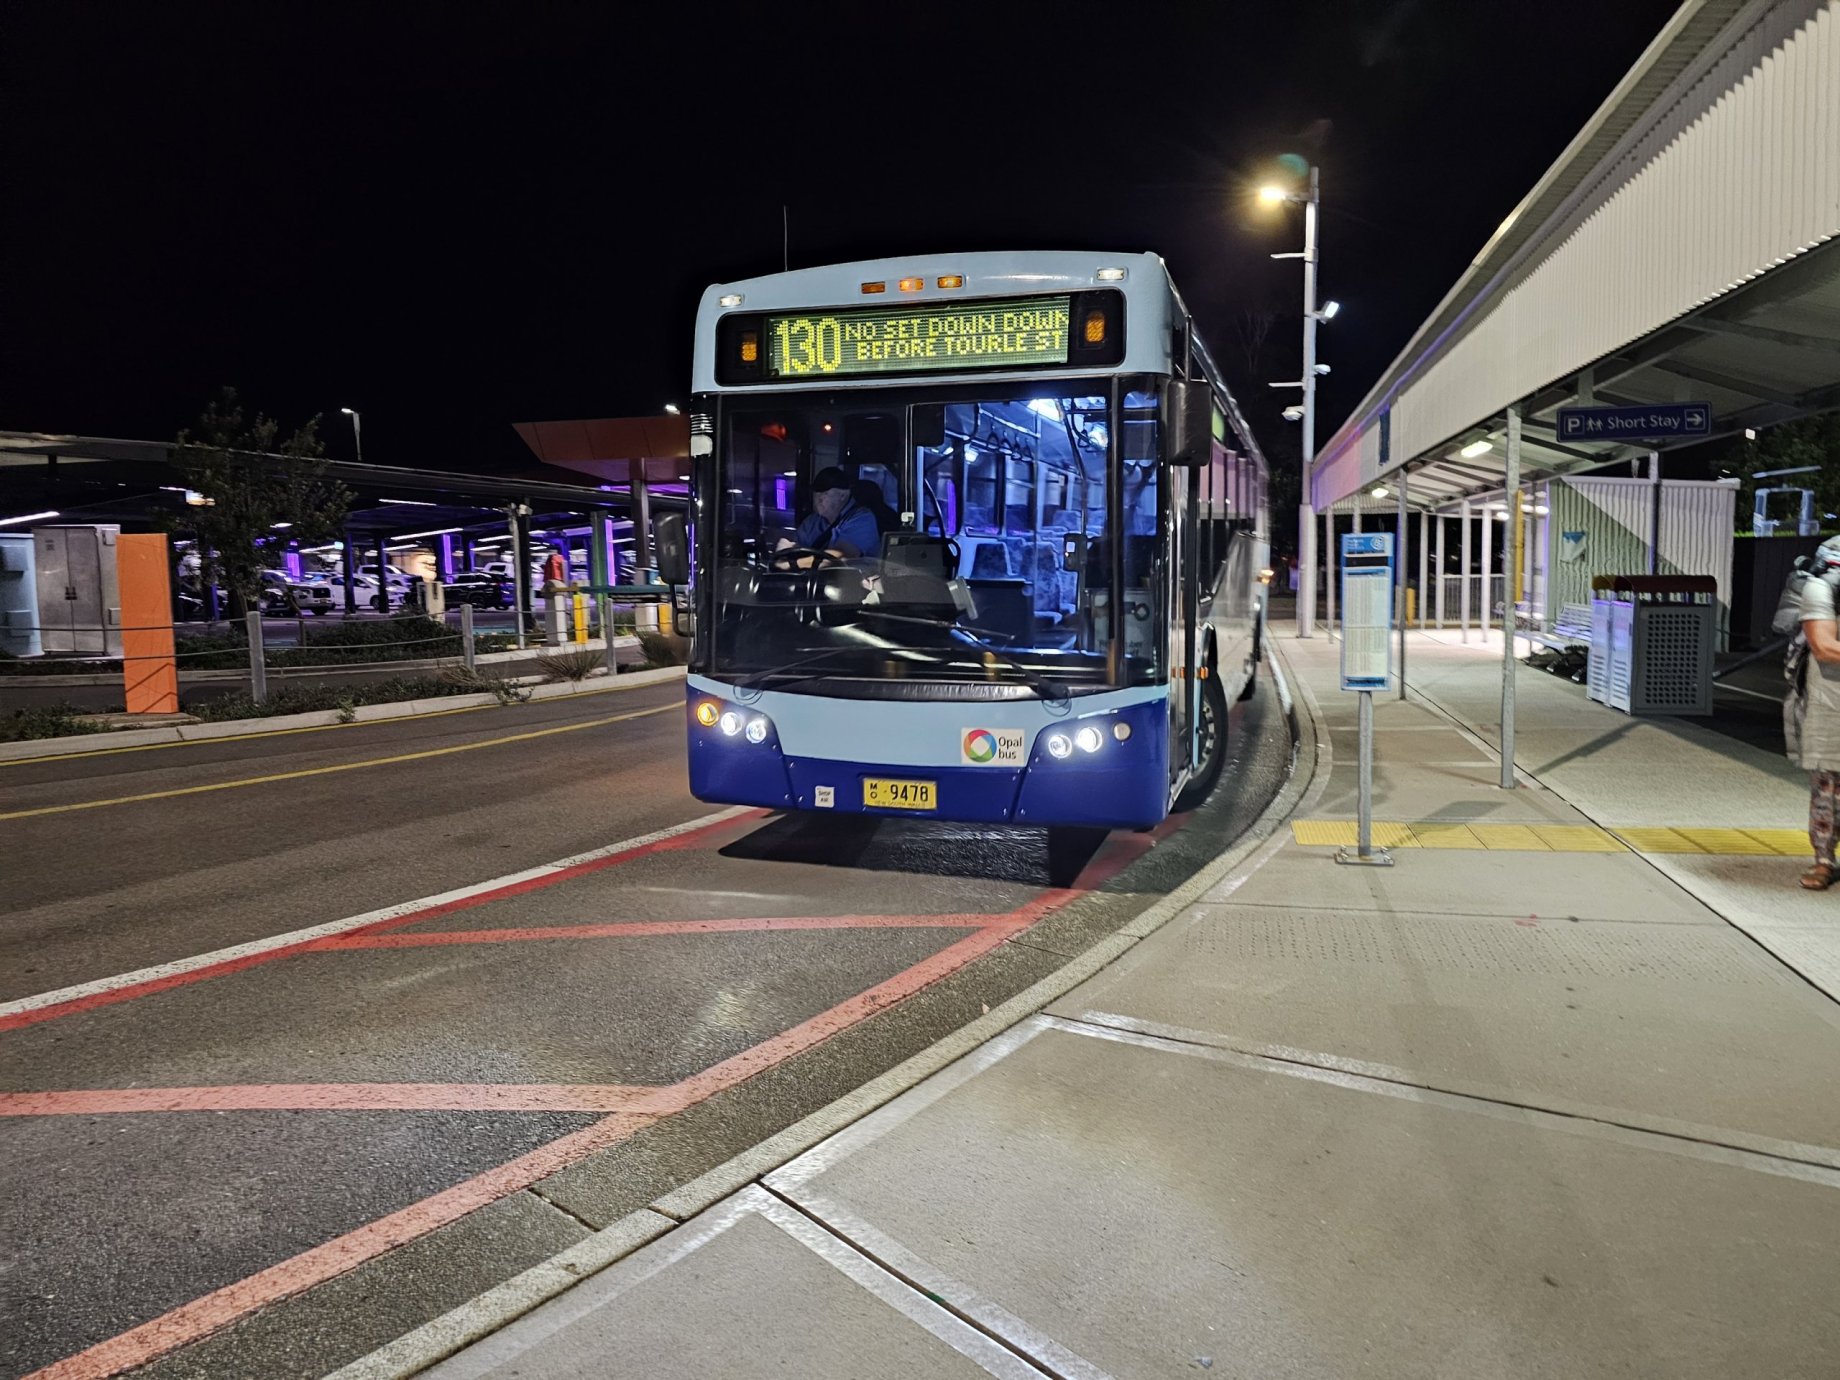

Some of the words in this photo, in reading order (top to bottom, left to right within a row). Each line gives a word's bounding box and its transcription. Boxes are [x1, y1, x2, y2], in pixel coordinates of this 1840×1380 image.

[845, 322, 876, 342] NO
[884, 319, 921, 338] SET
[928, 314, 995, 337] DOWN
[1003, 309, 1070, 333] DOWN
[776, 317, 841, 374] 130
[857, 337, 936, 360] BEFORE
[945, 332, 1027, 355] TOURLE
[1035, 331, 1062, 351] ST
[1567, 417, 1581, 433] P
[1607, 415, 1647, 430] Short
[1649, 414, 1681, 430] Stay
[998, 735, 1023, 750] Opal
[998, 748, 1017, 760] bus
[890, 783, 929, 802] 9478
